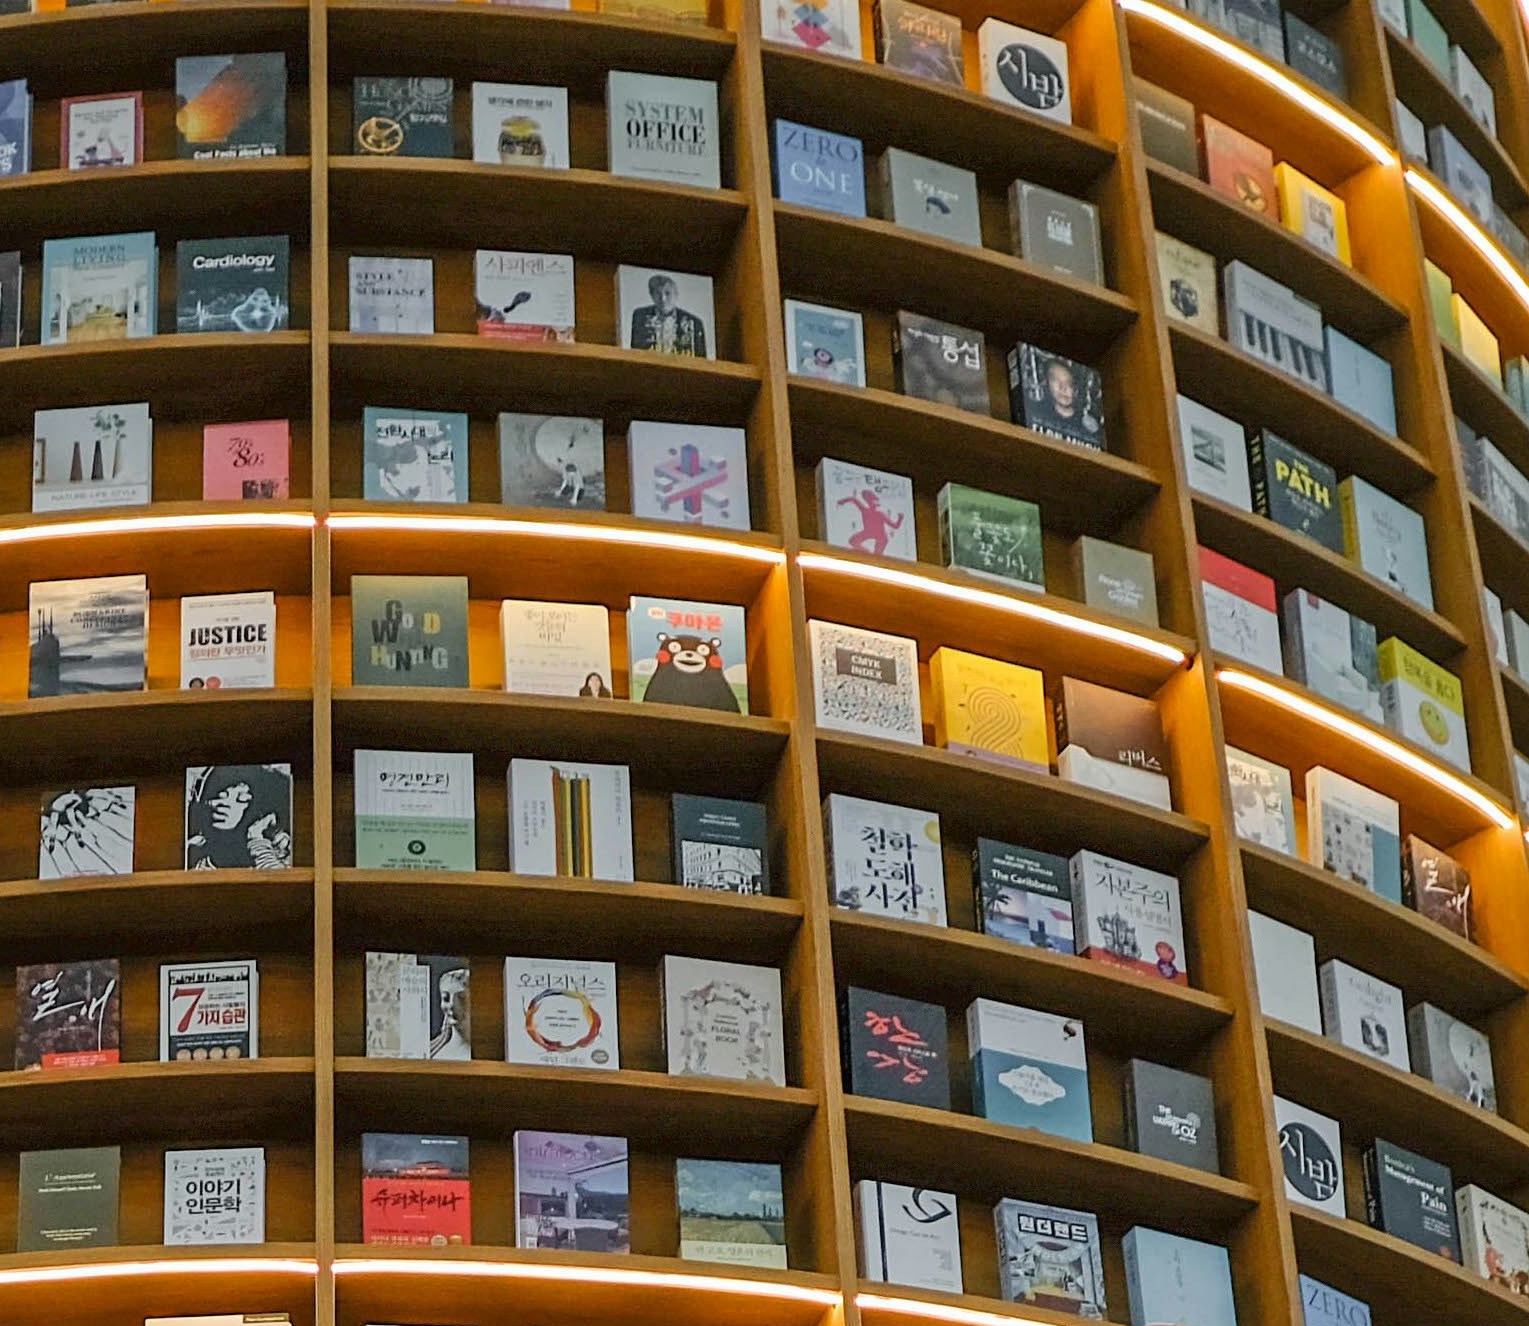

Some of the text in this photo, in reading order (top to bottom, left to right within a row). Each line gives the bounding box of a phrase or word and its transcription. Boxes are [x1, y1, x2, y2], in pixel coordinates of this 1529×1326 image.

[626, 101, 704, 124] SYSTEM
[627, 119, 705, 145] OFFICE
[783, 124, 859, 163] ZERO
[628, 140, 704, 158] FURNITURE
[790, 161, 854, 195] ONE
[193, 252, 276, 271] Cardiology
[485, 256, 566, 277] 사피엔스
[941, 334, 981, 371] 통섭
[1274, 458, 1332, 509] PATH
[665, 610, 723, 633] 쿠마몬
[188, 623, 268, 647] JUSTICE
[370, 646, 450, 672] HUNTING
[850, 653, 882, 669] CMYK
[850, 666, 883, 682] INDEX
[1118, 747, 1163, 773] 리버스
[992, 867, 1059, 894] The Caribbean
[1095, 872, 1171, 913] 자본주의
[518, 971, 608, 993] 오리지널스
[173, 987, 205, 1034] 7
[196, 1008, 247, 1027] 가지 습관
[185, 1178, 241, 1197] 이야기
[1384, 1163, 1434, 1193] Management
[185, 1197, 242, 1216] 인문학
[371, 1189, 463, 1213] 슈퍼차이나
[1420, 1190, 1448, 1214] Pain
[1017, 1215, 1090, 1243] 원더랜드
